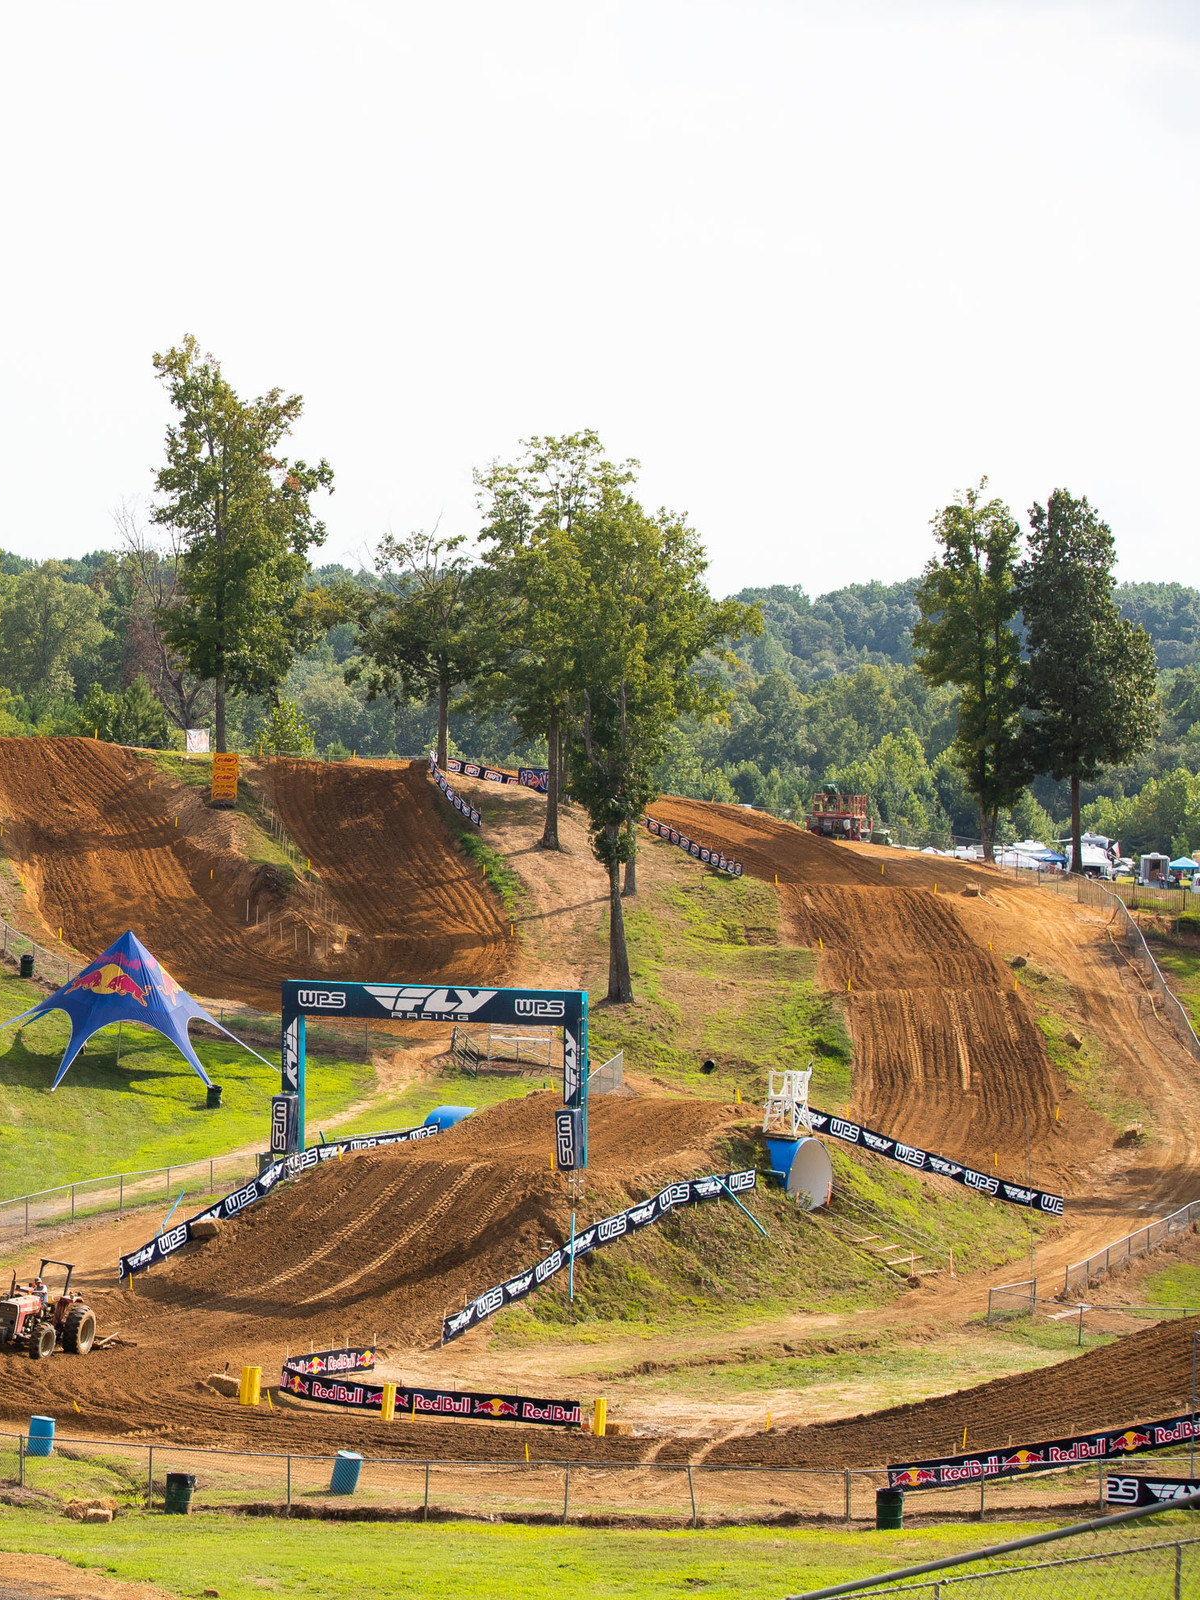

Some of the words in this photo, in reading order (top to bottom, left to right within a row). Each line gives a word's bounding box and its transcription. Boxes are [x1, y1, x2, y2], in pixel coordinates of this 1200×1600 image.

[298, 990, 346, 1009] WPS
[362, 986, 499, 1013] FLY
[515, 999, 565, 1017] WPS
[391, 1012, 469, 1021] RACING
[272, 1102, 287, 1150] WPS
[830, 1118, 860, 1142] WPS
[557, 1115, 574, 1165] WPS
[894, 1142, 926, 1168] WPS
[729, 1170, 756, 1192] WPS
[964, 1169, 999, 1195] WPS
[225, 1182, 258, 1214] WPS
[659, 1184, 690, 1210] WPS
[158, 1224, 187, 1254] WPS
[598, 1214, 627, 1241] WPS
[535, 1250, 561, 1283] WPS
[477, 1287, 503, 1318] WPS
